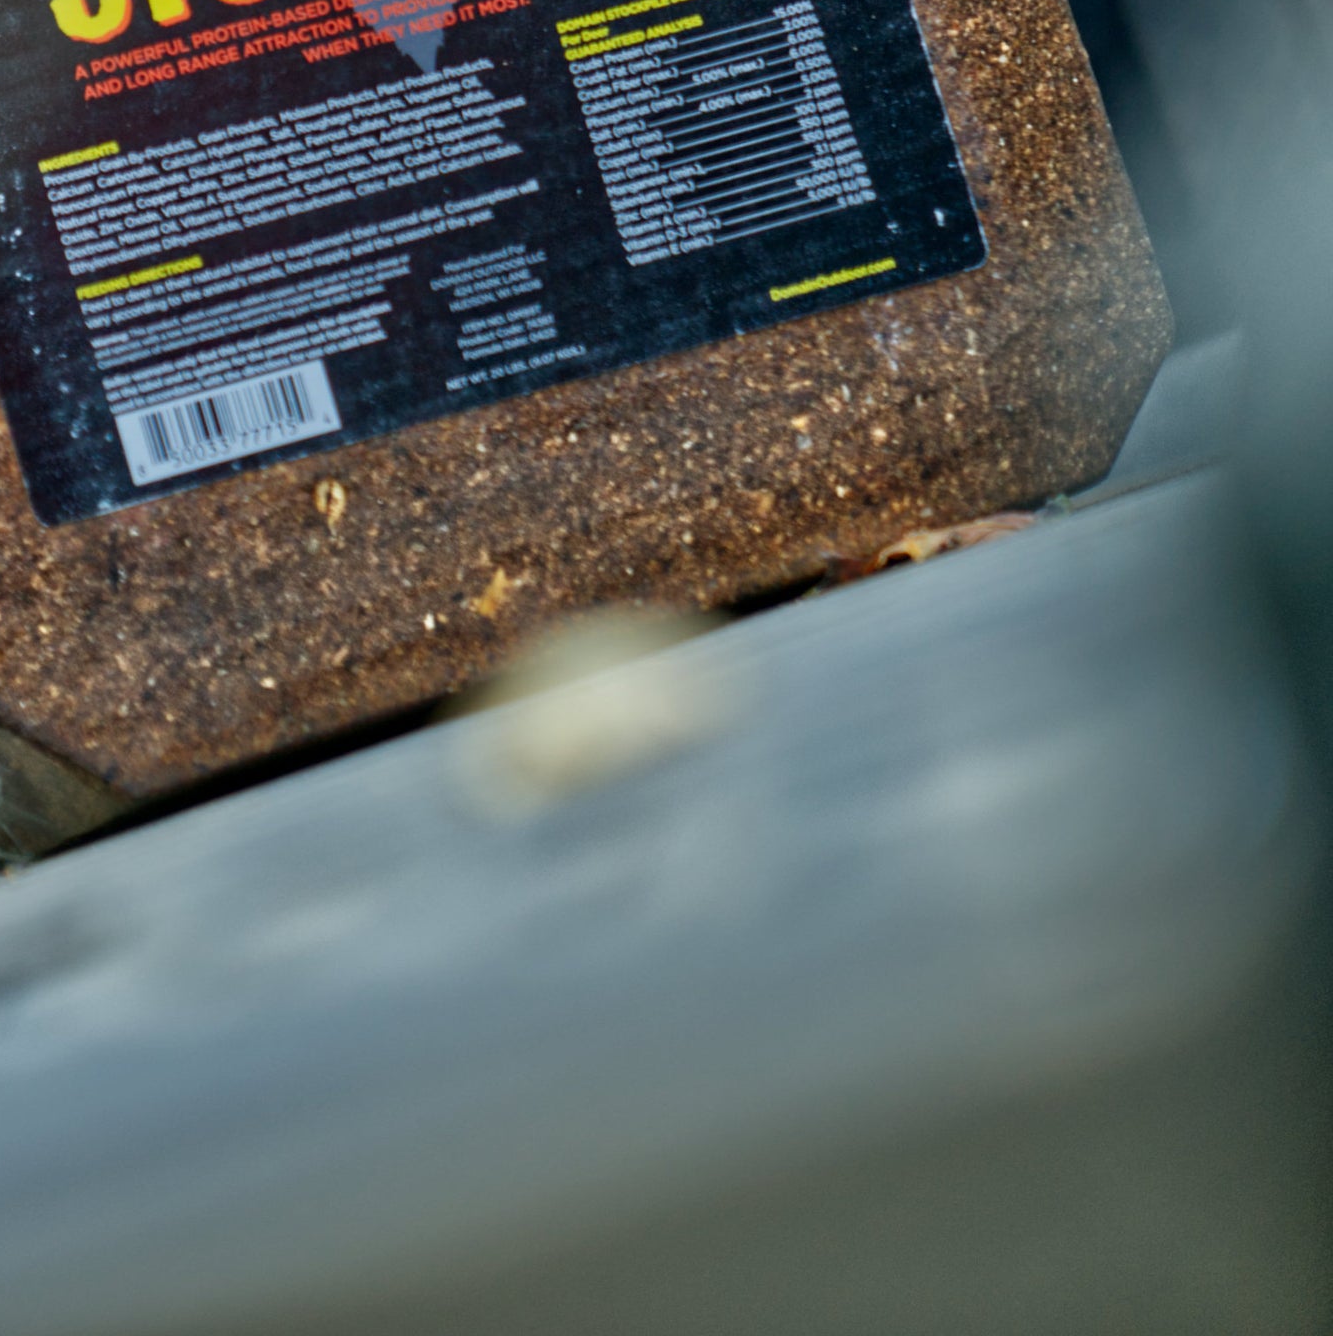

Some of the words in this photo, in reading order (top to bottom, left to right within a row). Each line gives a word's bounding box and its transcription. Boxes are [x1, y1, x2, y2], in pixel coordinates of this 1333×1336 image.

[73, 64, 88, 79] A
[91, 38, 188, 74] POWERFUL
[191, 0, 330, 47] PROTEIN-BASED
[302, 37, 359, 63] WHEN
[360, 24, 404, 47] THEY
[407, 10, 457, 35] NEED
[459, 5, 476, 21] IT
[556, 11, 605, 33] DOMAIN
[560, 33, 580, 46] For
[581, 25, 609, 41] Deer
[564, 30, 645, 60] GUARANTEED
[646, 14, 703, 38] ANALYSIS
[82, 77, 123, 99] AND
[125, 63, 174, 88] LONG
[177, 46, 239, 74] RANGE
[241, 16, 352, 57] ATTRACTION
[353, 9, 379, 27] TO
[38, 142, 119, 172] INGREDIENTS
[76, 275, 129, 300] FEEDING
[128, 255, 203, 285] DIRECTIONS
[769, 257, 896, 301] DomainOutdoor.com
